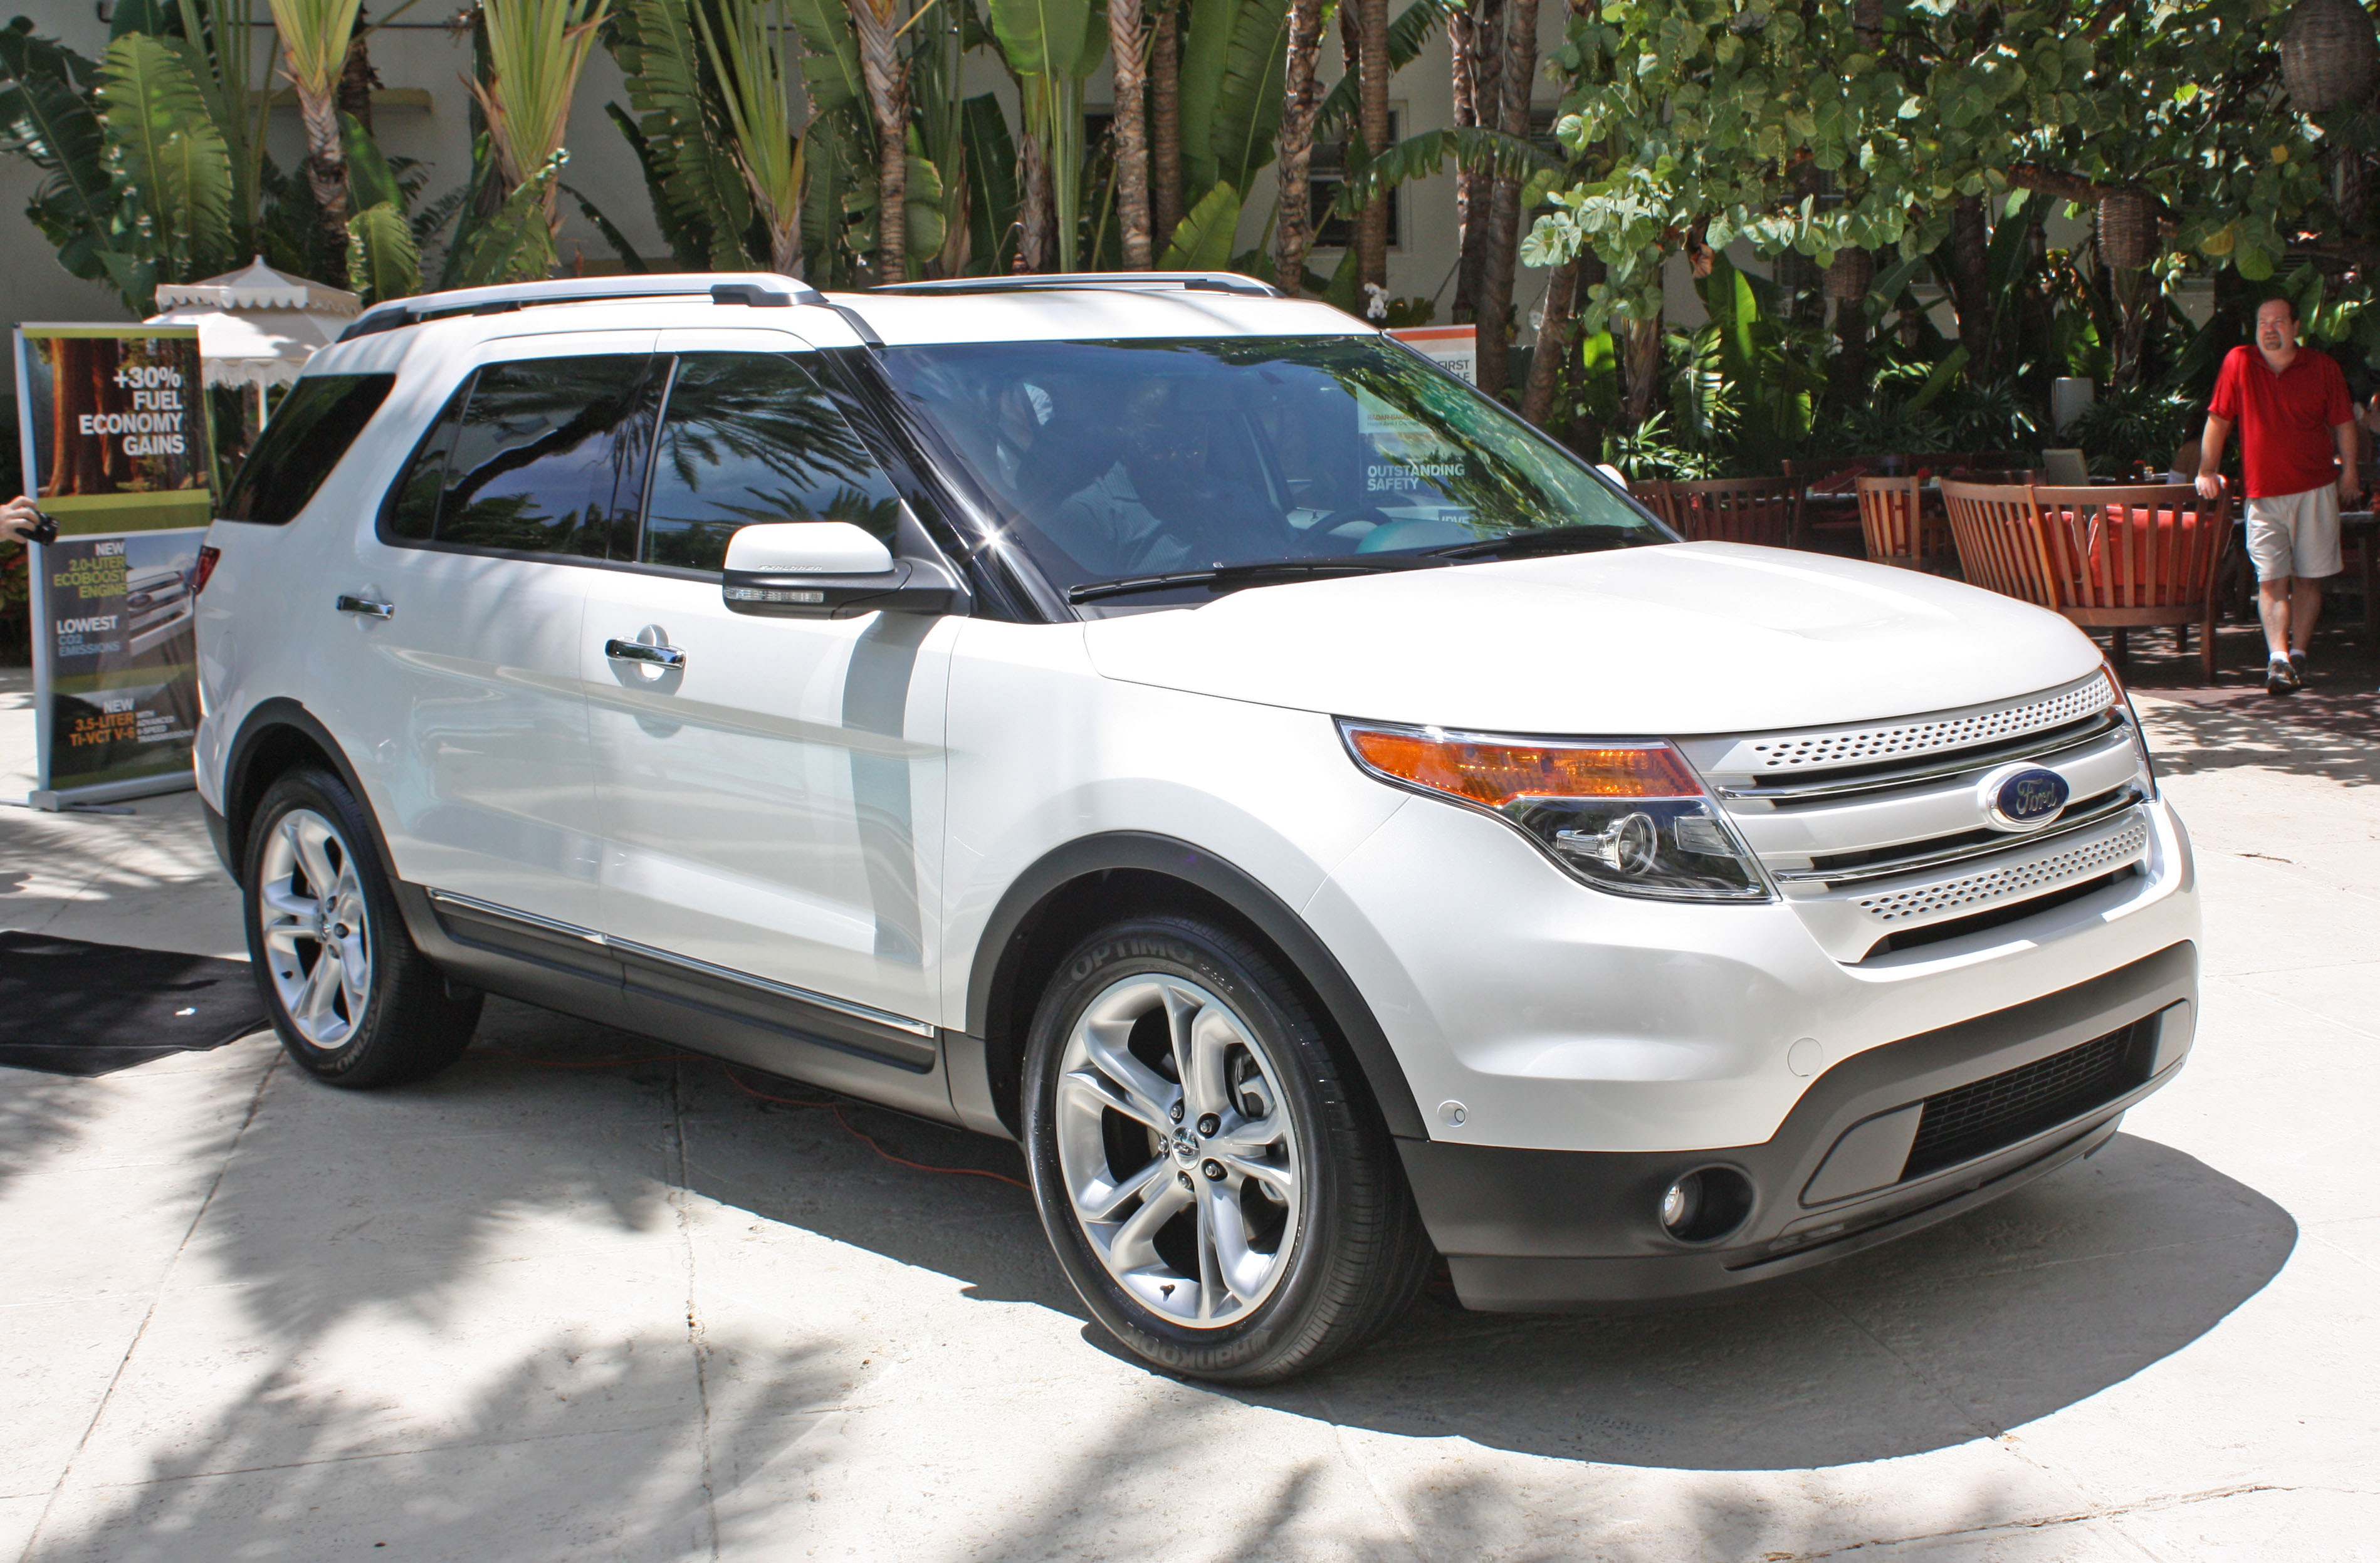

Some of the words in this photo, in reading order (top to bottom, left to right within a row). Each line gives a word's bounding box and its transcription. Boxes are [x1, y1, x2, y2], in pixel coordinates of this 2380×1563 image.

[113, 366, 181, 389] +30%
[133, 391, 182, 410] FUEL
[78, 412, 184, 435] ECONOMY
[123, 434, 185, 456] GAINS
[1367, 464, 1465, 477] OUTSTANDING
[1367, 478, 1419, 491] SAFETY
[95, 542, 125, 557] NEW
[69, 556, 125, 572] 2.0-LITER
[53, 568, 126, 587] ECOBOOST
[79, 582, 127, 599] ENGINE
[56, 615, 118, 635] LOWEST
[59, 641, 120, 657] EMISSIONS
[103, 698, 135, 714] NEW
[75, 711, 134, 732] 3.5-LITER
[113, 727, 135, 741] V-6
[2016, 778, 2057, 815] Ford
[1071, 940, 1193, 981] OPTIMO
